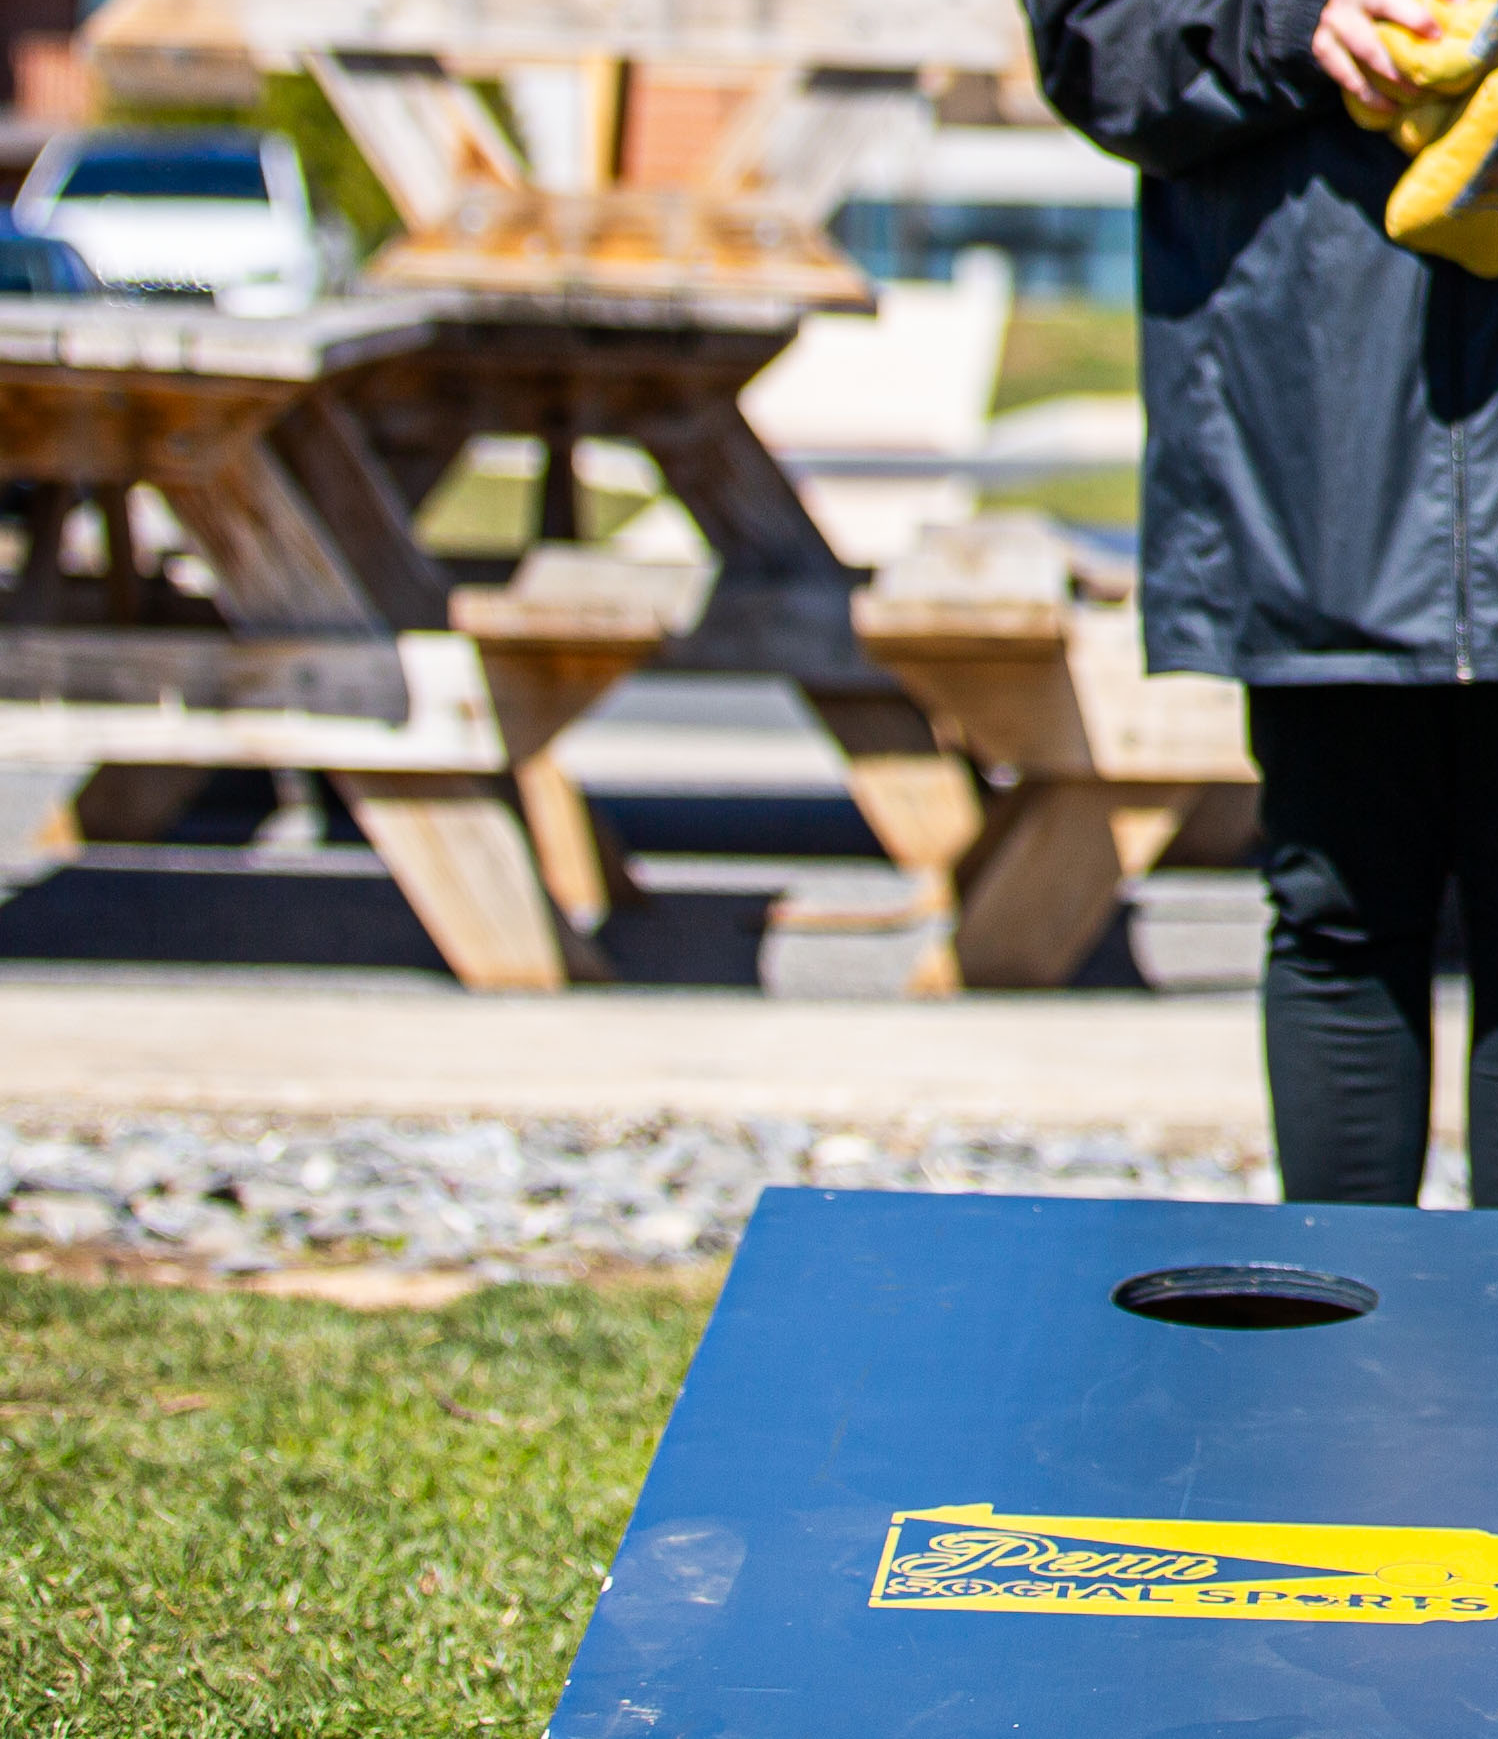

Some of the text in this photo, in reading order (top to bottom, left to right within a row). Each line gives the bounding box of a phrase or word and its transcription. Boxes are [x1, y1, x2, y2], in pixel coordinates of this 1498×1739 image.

[890, 1528, 1220, 1581] Penn
[885, 1578, 1490, 1612] SOCIAL SPORTS
